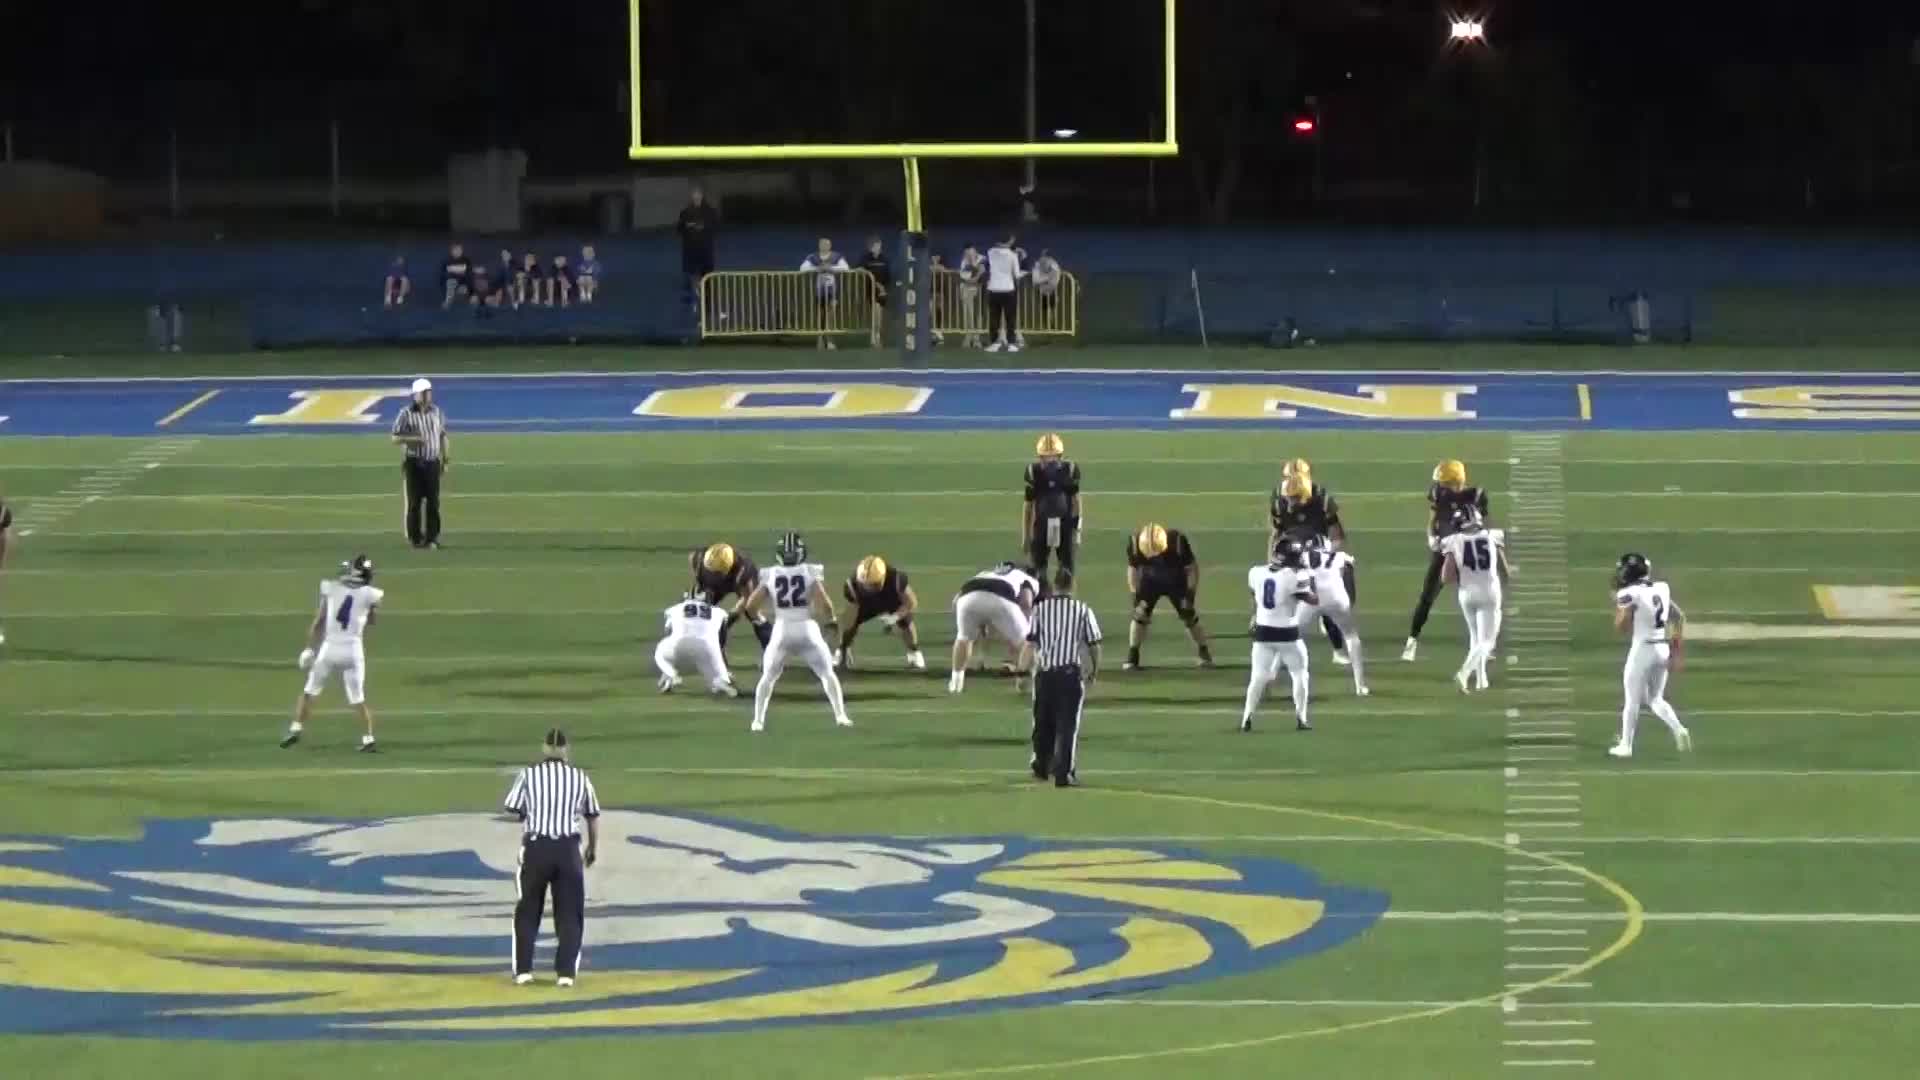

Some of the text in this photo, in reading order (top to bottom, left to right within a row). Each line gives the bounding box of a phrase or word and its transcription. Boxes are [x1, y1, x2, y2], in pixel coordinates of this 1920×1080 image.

[905, 245, 916, 350] LIONS
[1462, 537, 1491, 571] 45
[775, 575, 808, 608] 22
[336, 594, 353, 630] 4
[1652, 594, 1665, 629] 2
